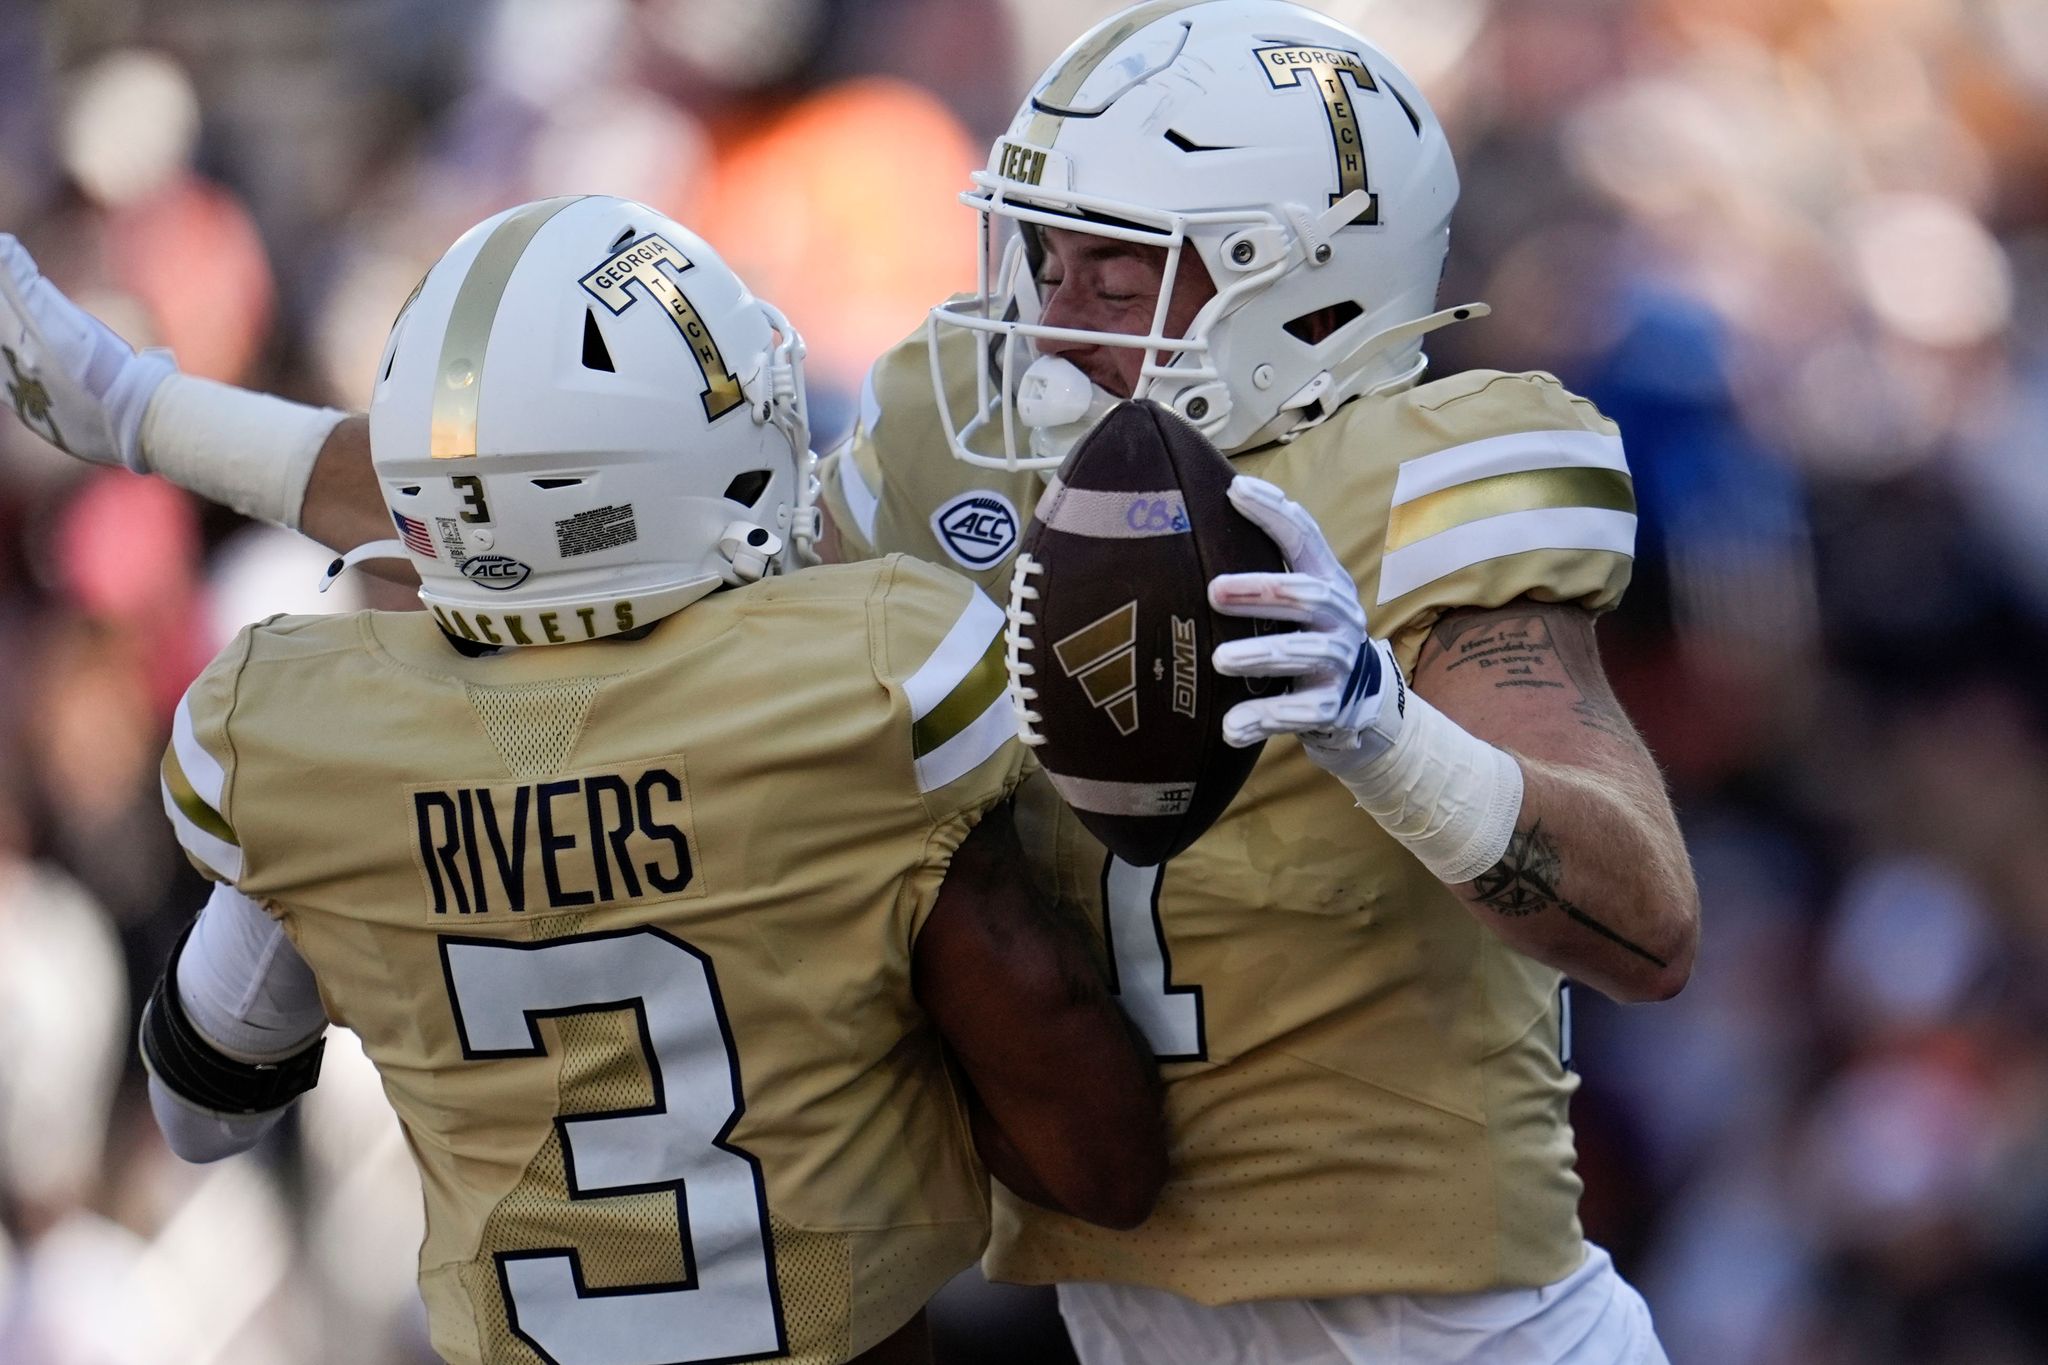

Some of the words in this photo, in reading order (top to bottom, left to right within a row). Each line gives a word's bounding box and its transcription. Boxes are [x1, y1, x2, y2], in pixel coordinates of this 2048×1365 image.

[1271, 52, 1360, 69] GEORGIA
[1325, 79, 1357, 171] TECH
[998, 142, 1047, 186] TECH
[595, 241, 668, 290] GEORGIA
[651, 278, 714, 364] TECH
[452, 475, 490, 524] 3
[951, 513, 1009, 540] ACC
[472, 562, 518, 577] ACC
[1171, 614, 1198, 719] DIME
[414, 769, 693, 914] RIVERS
[437, 925, 789, 1365] 3
